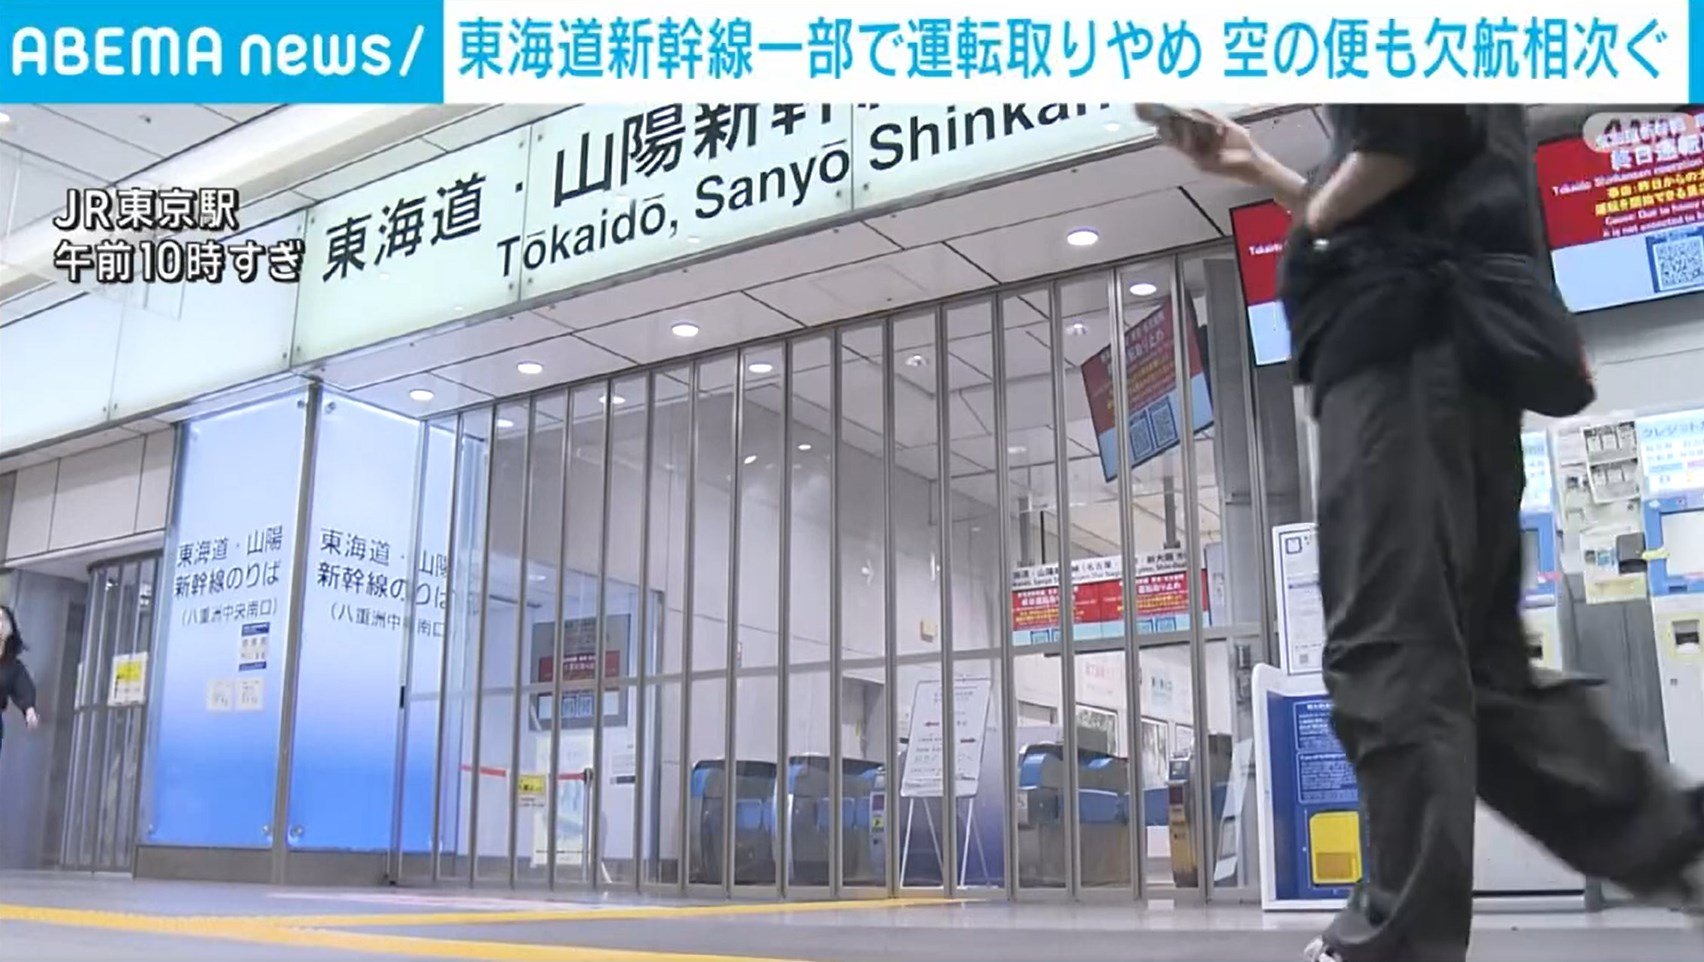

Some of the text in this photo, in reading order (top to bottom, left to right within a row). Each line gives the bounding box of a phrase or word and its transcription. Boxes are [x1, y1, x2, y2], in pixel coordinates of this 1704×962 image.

[497, 193, 677, 277] Tōkaidō,
[695, 139, 850, 219] Sanyō
[177, 525, 283, 568] 東海道・山陽
[174, 560, 281, 600] 新幹線のりば
